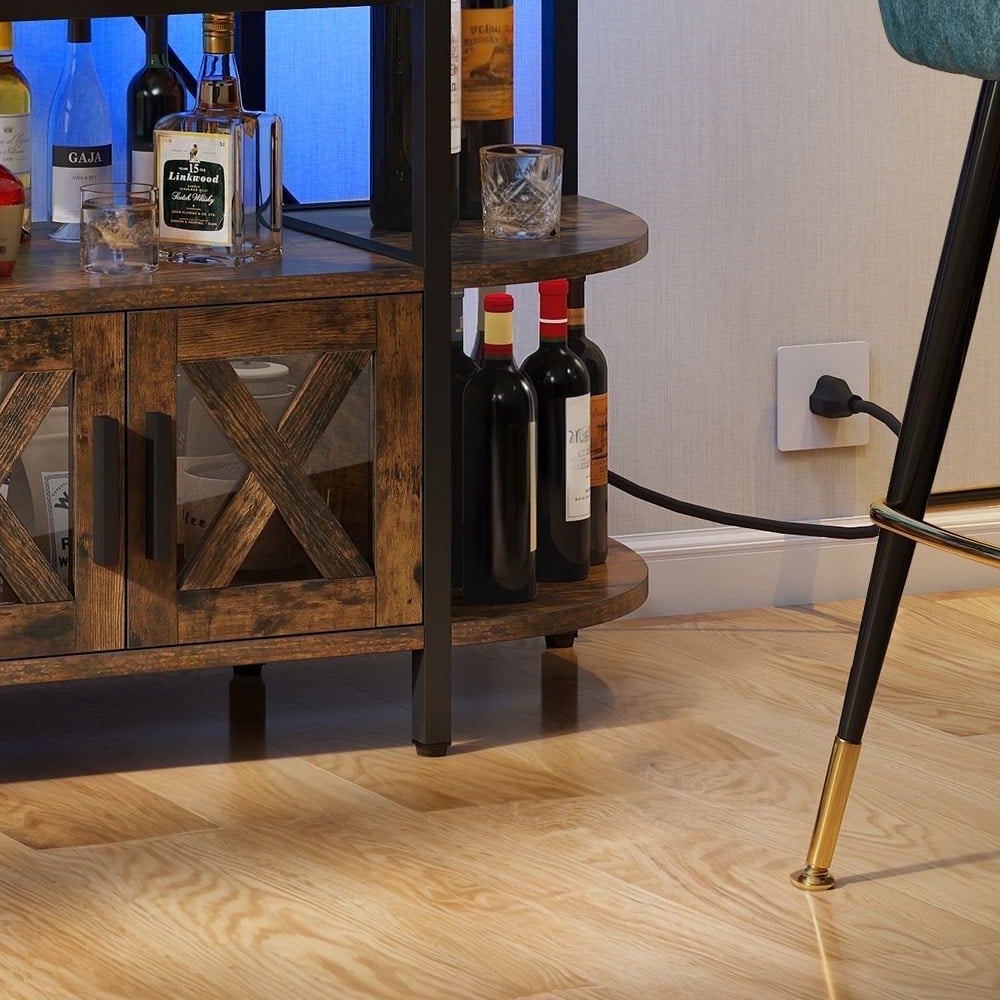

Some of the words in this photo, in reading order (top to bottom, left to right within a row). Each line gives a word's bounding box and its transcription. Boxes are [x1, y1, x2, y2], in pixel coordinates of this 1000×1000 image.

[68, 152, 103, 163] GAJA
[188, 163, 200, 174] 15
[168, 171, 219, 184] Linkwood
